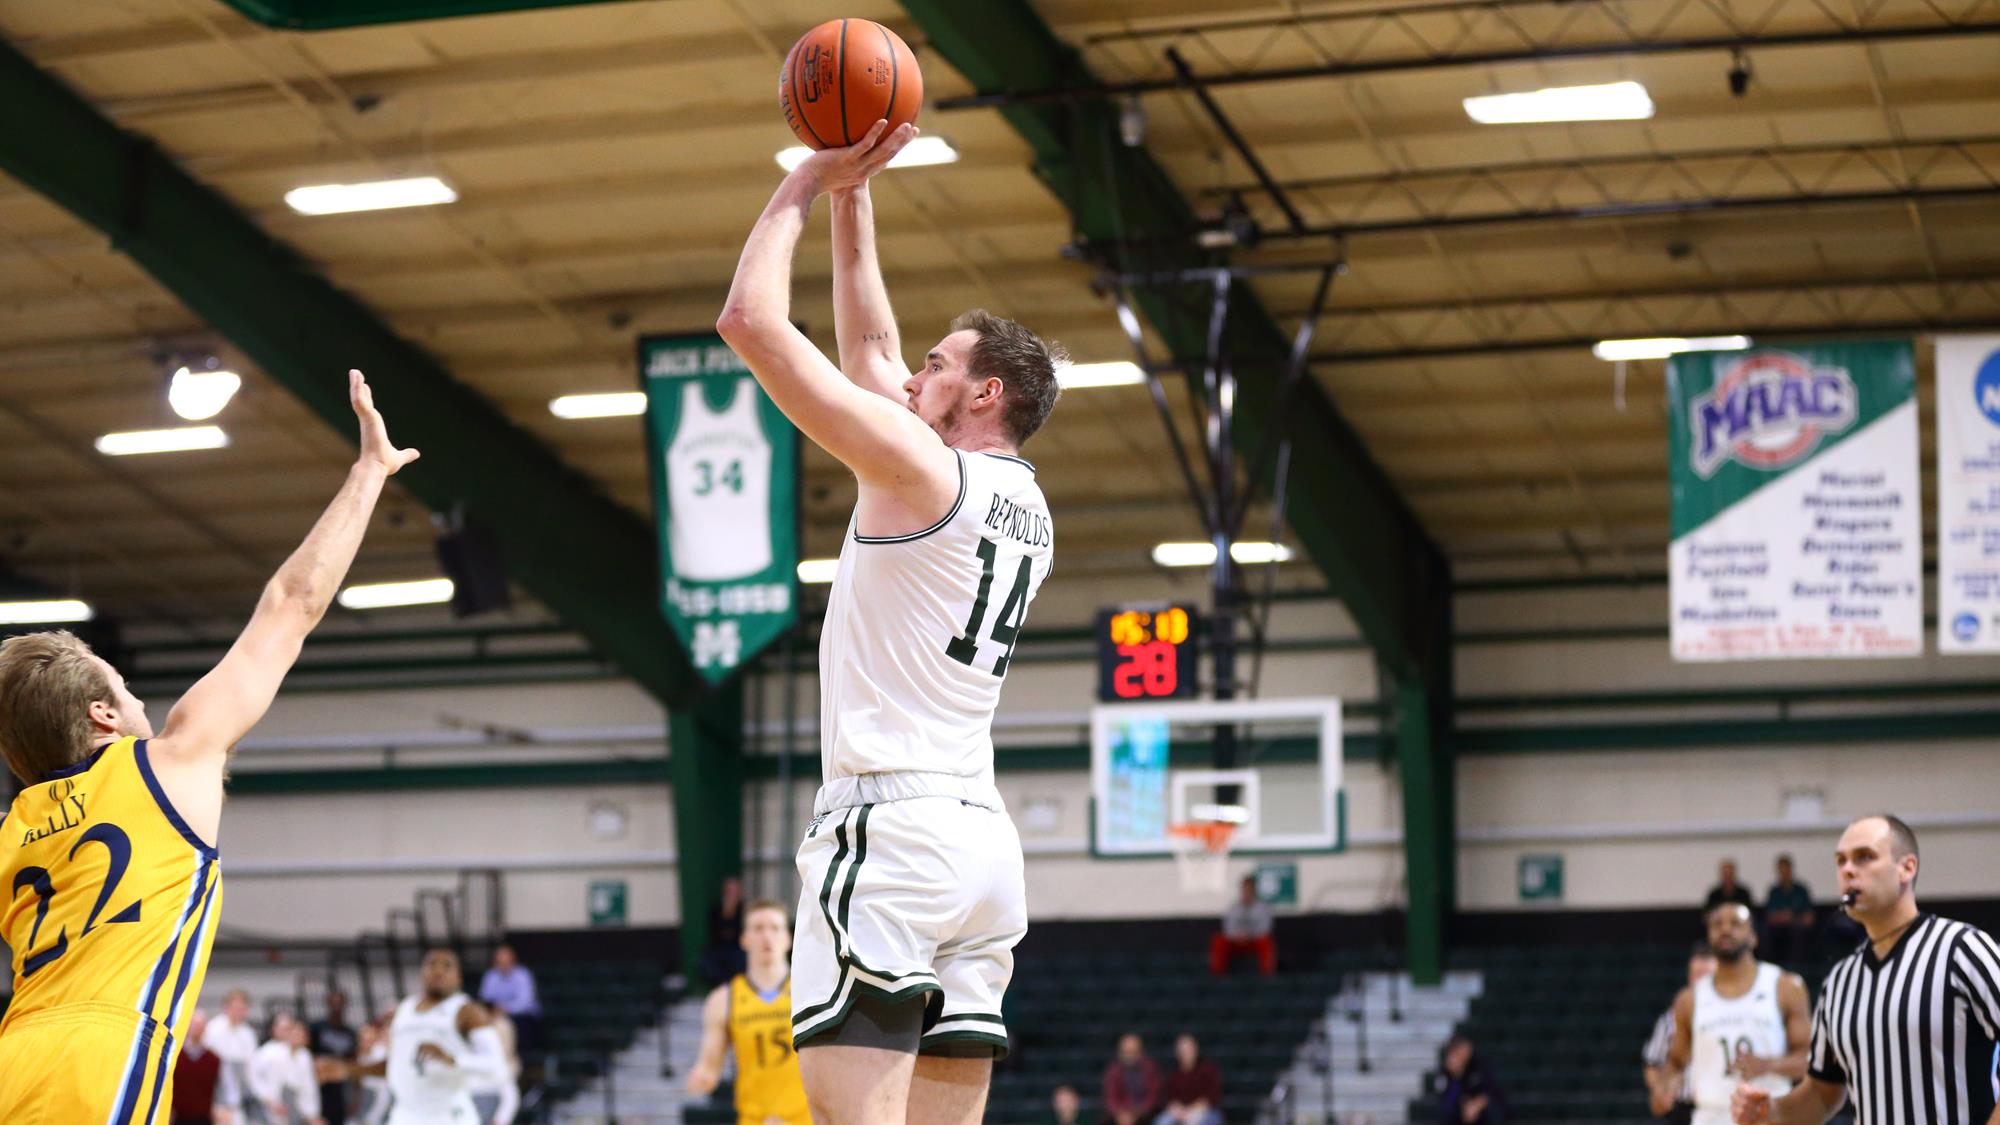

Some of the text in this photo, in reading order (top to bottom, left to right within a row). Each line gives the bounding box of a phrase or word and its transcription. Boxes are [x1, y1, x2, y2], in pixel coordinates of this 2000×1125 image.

[1700, 375, 1842, 457] MAAC
[692, 458, 744, 496] 34
[984, 492, 1050, 548] REYNOLDS
[945, 536, 1032, 678] 14
[1114, 641, 1177, 698] 28
[13, 823, 142, 978] 22
[755, 1026, 792, 1068] 15
